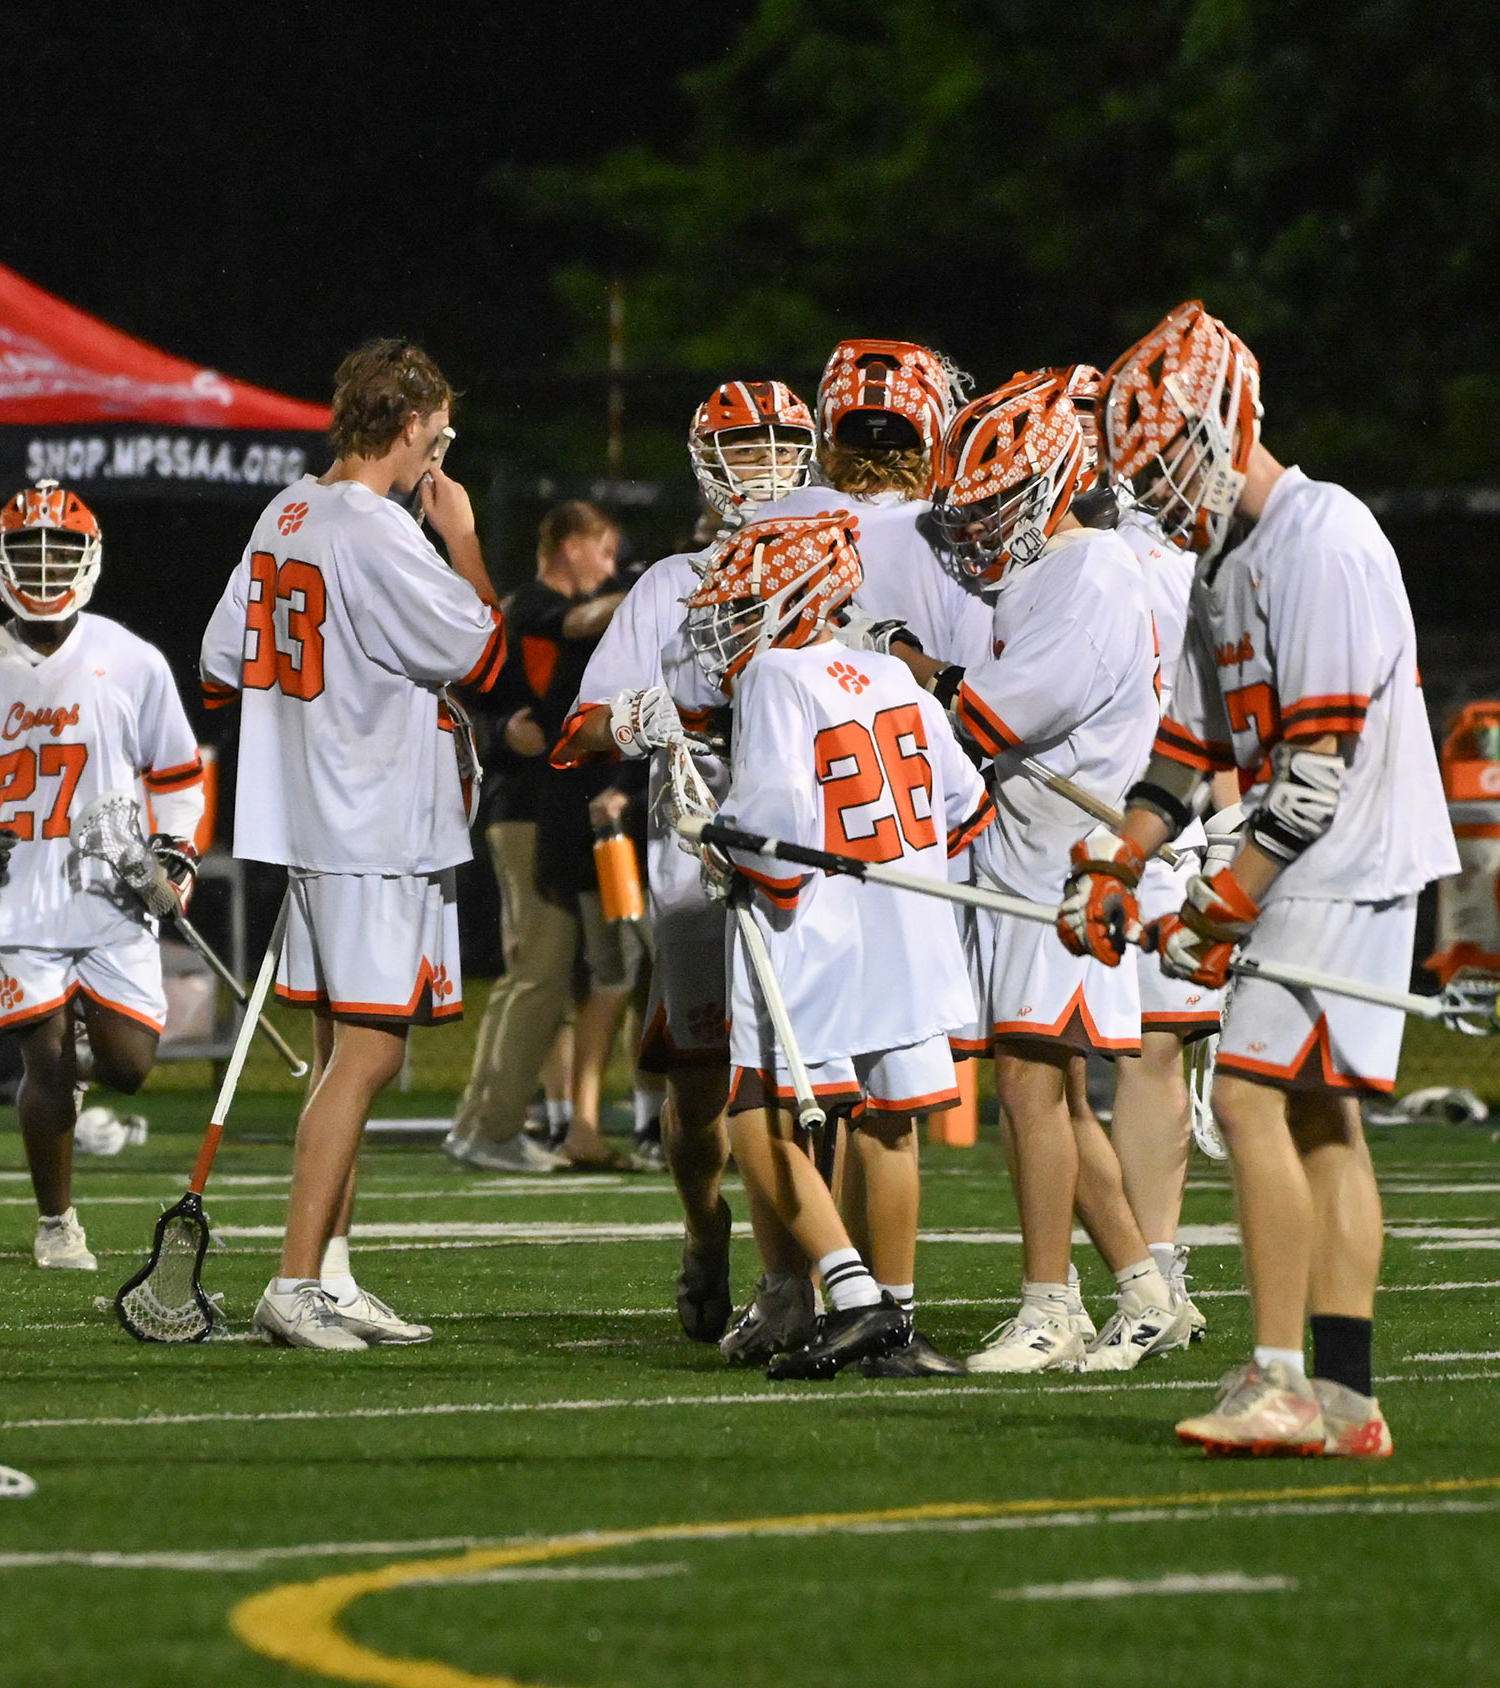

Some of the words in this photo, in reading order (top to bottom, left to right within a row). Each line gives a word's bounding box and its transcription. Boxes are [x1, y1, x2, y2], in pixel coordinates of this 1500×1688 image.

[26, 436, 304, 485] SHOP.MPSSAA.ORG
[1, 701, 81, 741] Cougs
[814, 702, 938, 878] 26
